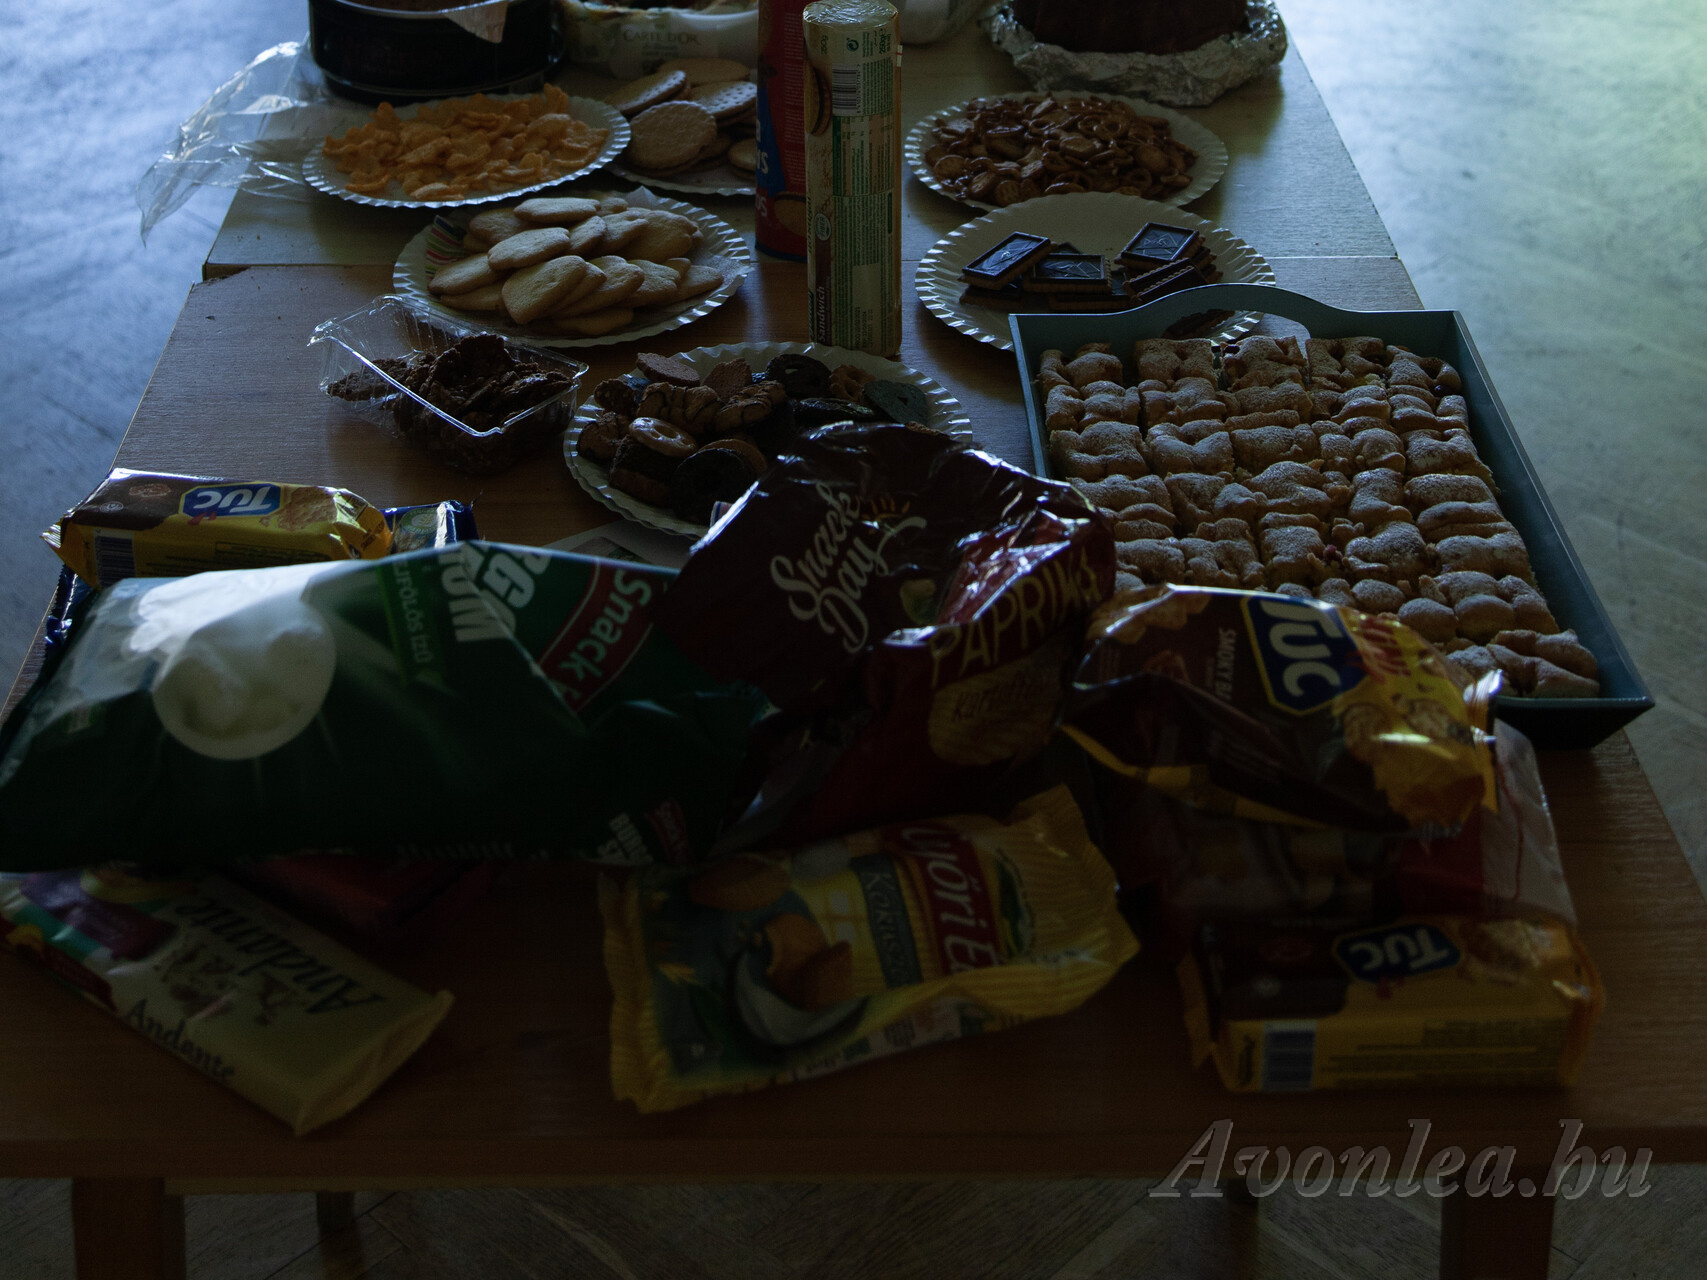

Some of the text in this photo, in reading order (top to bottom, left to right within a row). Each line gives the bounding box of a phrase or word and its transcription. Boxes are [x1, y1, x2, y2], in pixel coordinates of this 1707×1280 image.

[816, 285, 827, 343] Sandwich
[191, 485, 274, 514] TUC
[769, 481, 863, 622] Snack
[816, 516, 929, 654] Day
[1259, 599, 1345, 698] TUC
[1349, 927, 1450, 970] TUC
